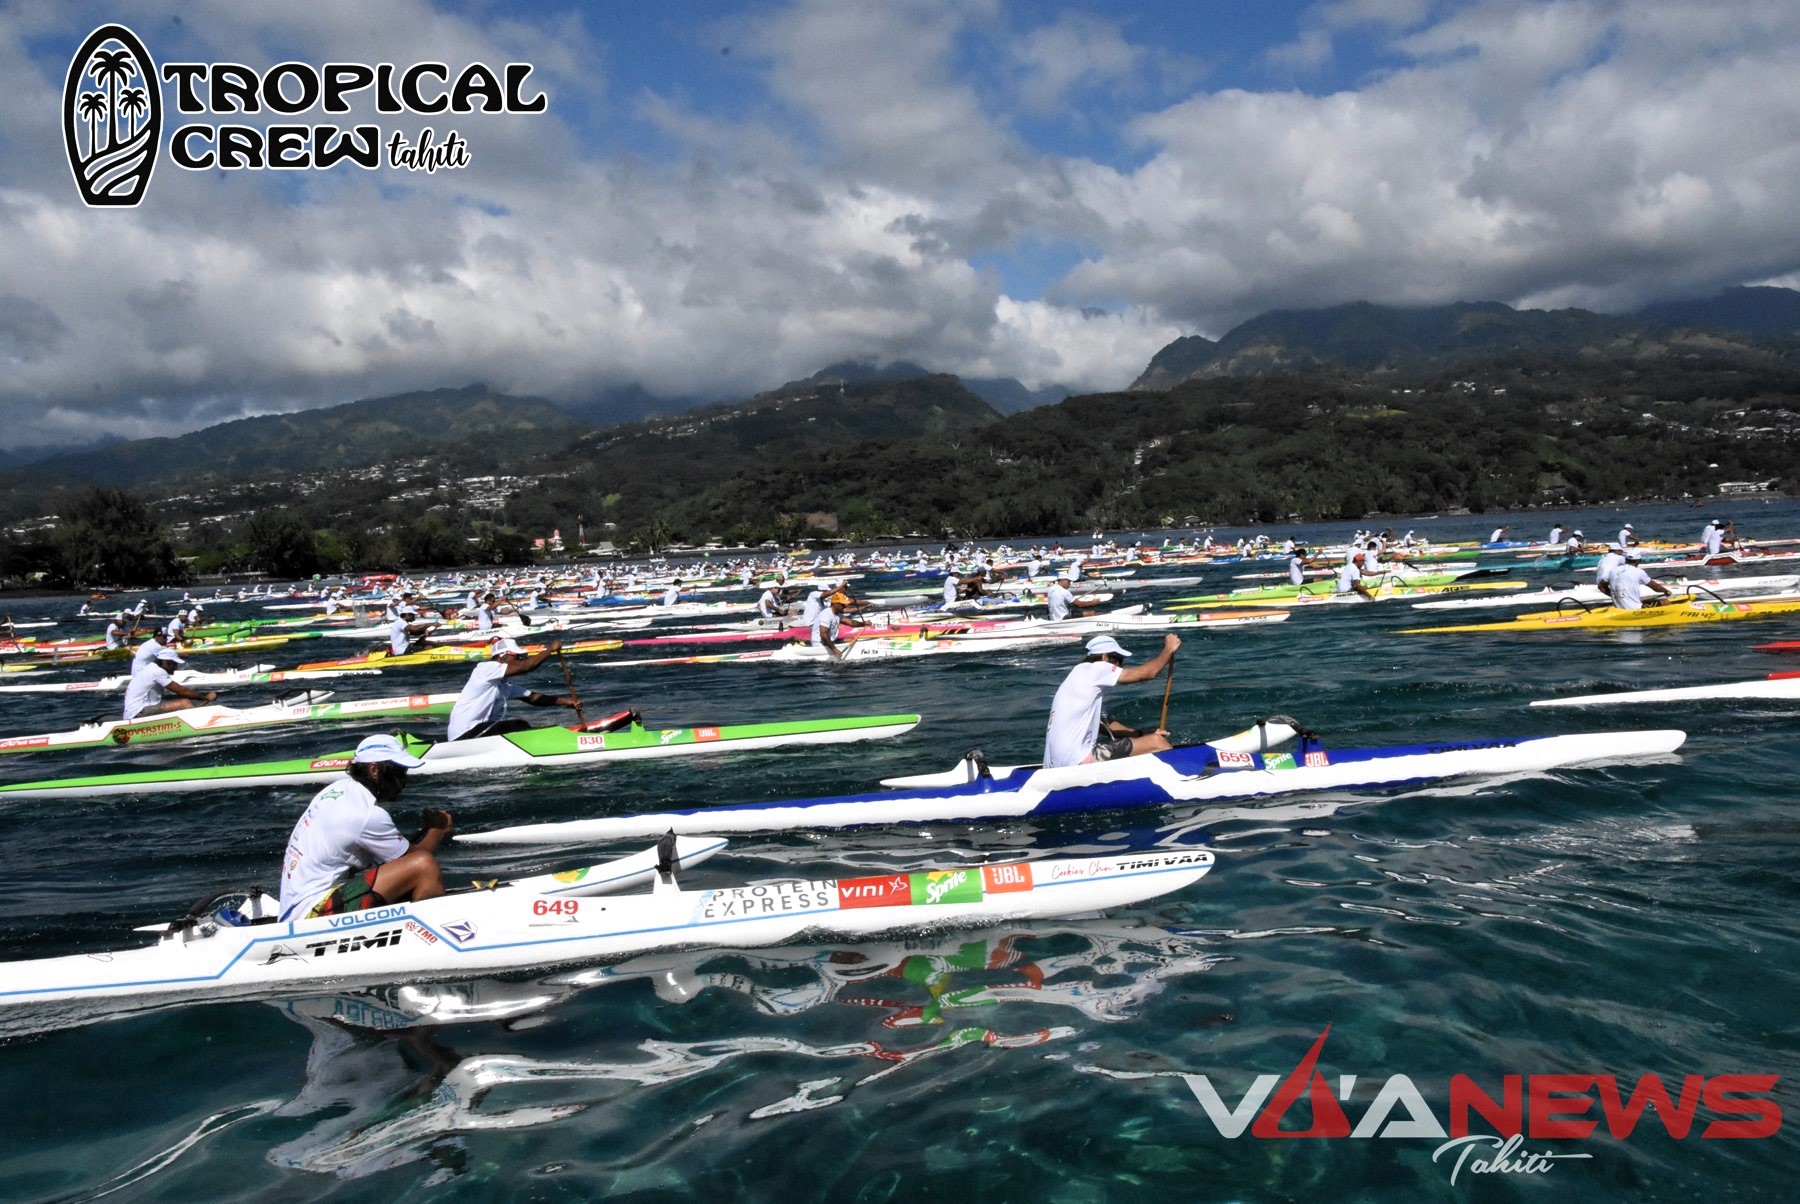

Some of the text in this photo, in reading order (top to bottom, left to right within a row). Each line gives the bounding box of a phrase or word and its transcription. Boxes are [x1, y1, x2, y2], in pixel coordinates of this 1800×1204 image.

[580, 736, 603, 745] 830
[1220, 752, 1251, 763] 659
[1264, 752, 1292, 769] Sprite
[1308, 751, 1329, 767] JBL
[1116, 853, 1207, 871] TIMI VAA
[993, 867, 1025, 885] JBL
[926, 871, 967, 903] Sprite
[533, 900, 579, 915] 649
[704, 892, 829, 918] EXPRESS
[328, 906, 406, 928] VOLCOM
[306, 928, 403, 957] TIMI
